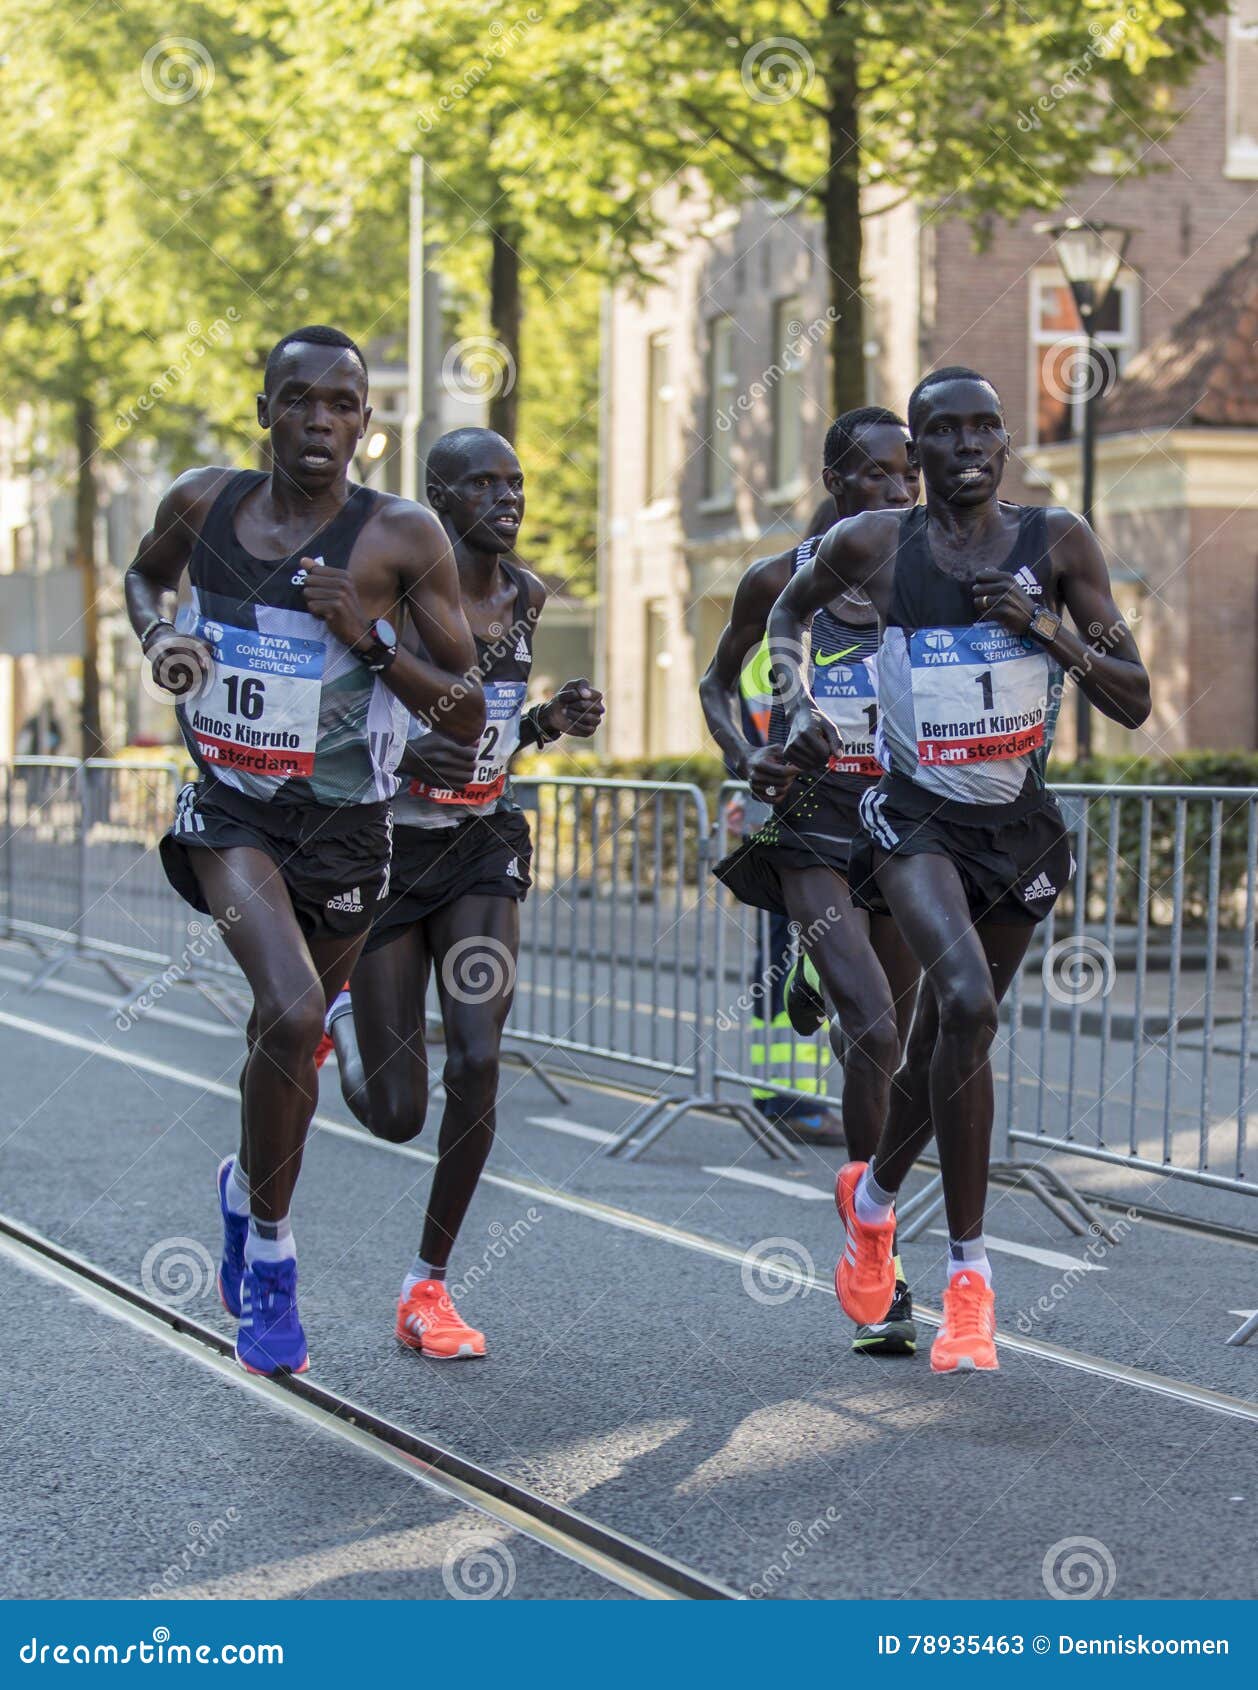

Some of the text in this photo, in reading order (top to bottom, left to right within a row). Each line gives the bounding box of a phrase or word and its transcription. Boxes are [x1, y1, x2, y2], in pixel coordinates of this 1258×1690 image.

[259, 636, 291, 649] TATA
[236, 645, 312, 664] CONSULTANCY
[922, 651, 961, 664] TATA
[984, 646, 1027, 662] SERVICES
[248, 658, 297, 674] SERVICES
[222, 675, 266, 720] 16
[824, 686, 858, 695] TATA
[975, 671, 994, 710] 1
[192, 710, 300, 749] Amos Kipruto
[921, 719, 986, 737] Bernard
[478, 726, 499, 761] 2
[845, 741, 874, 754] rius
[327, 899, 364, 912] adidas
